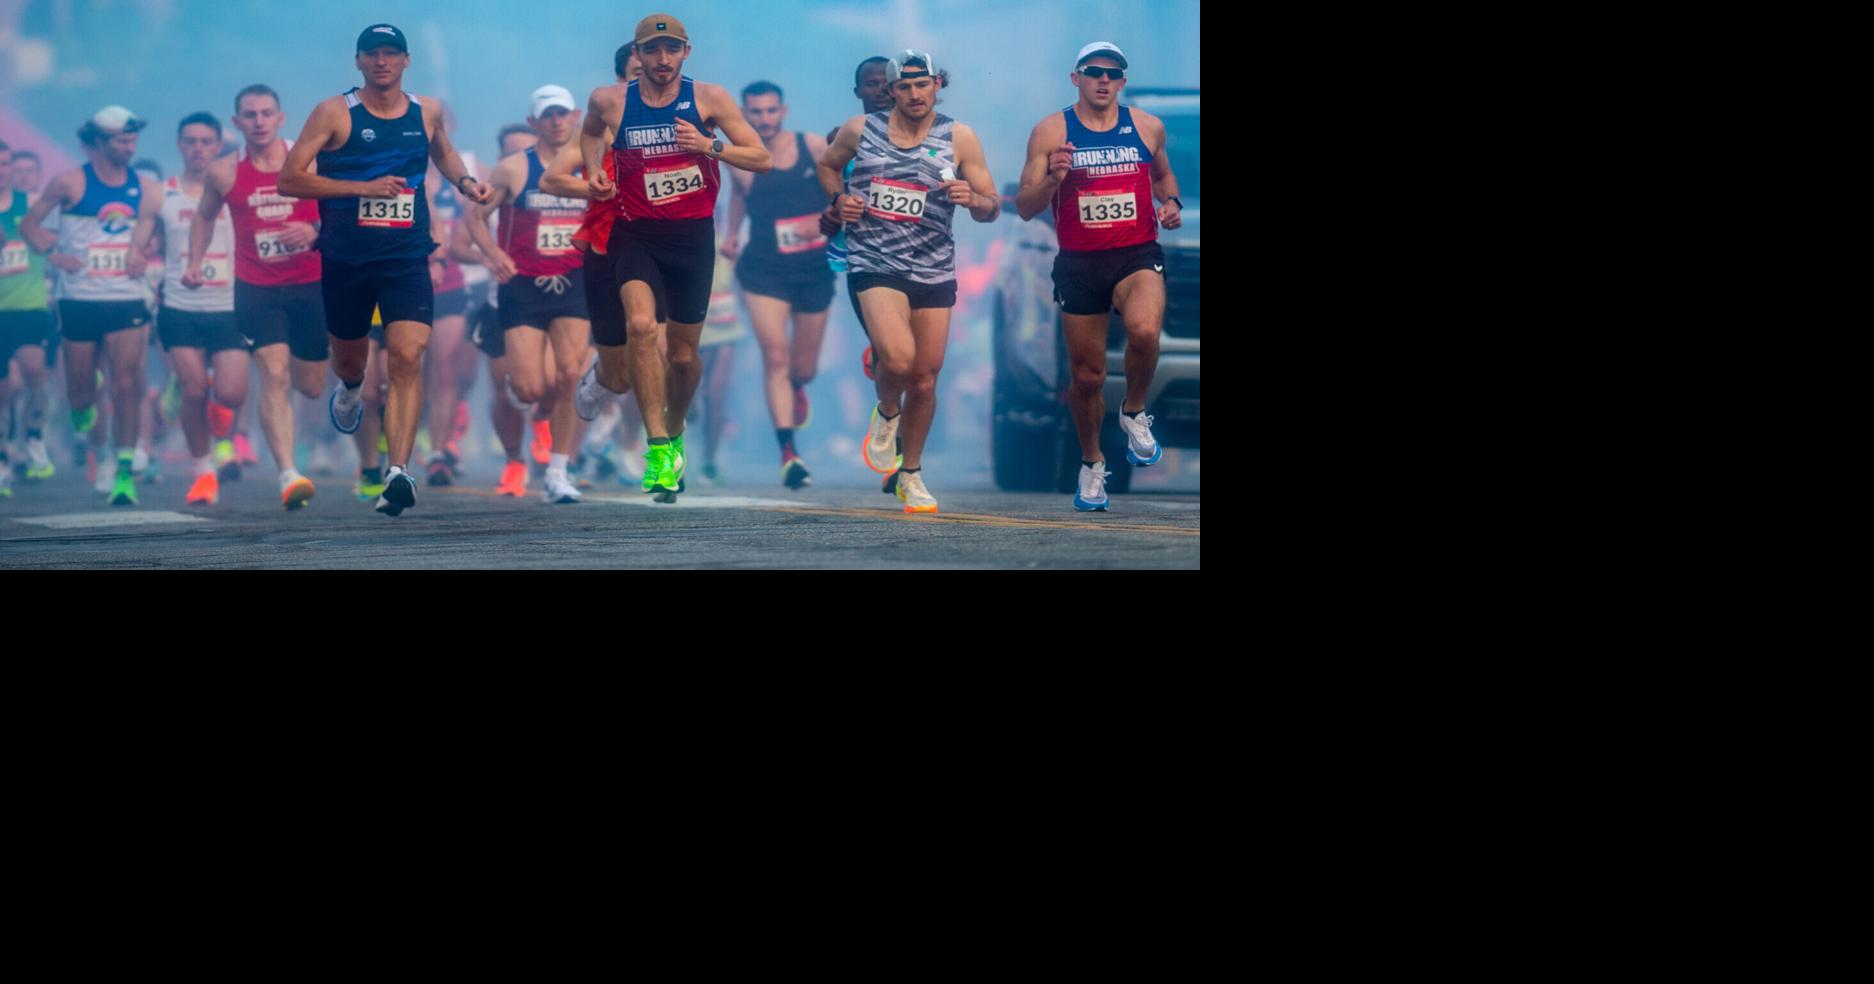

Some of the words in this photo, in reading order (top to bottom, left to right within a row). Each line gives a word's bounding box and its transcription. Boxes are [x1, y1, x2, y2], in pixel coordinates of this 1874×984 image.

[644, 144, 680, 156] NEBRAS
[1089, 163, 1135, 175] NEBRASKA
[648, 174, 703, 198] 1334
[362, 201, 412, 219] 1315
[870, 192, 923, 215] 1320
[1082, 201, 1135, 221] 1335
[540, 233, 574, 248] 133
[92, 254, 123, 269] 131
